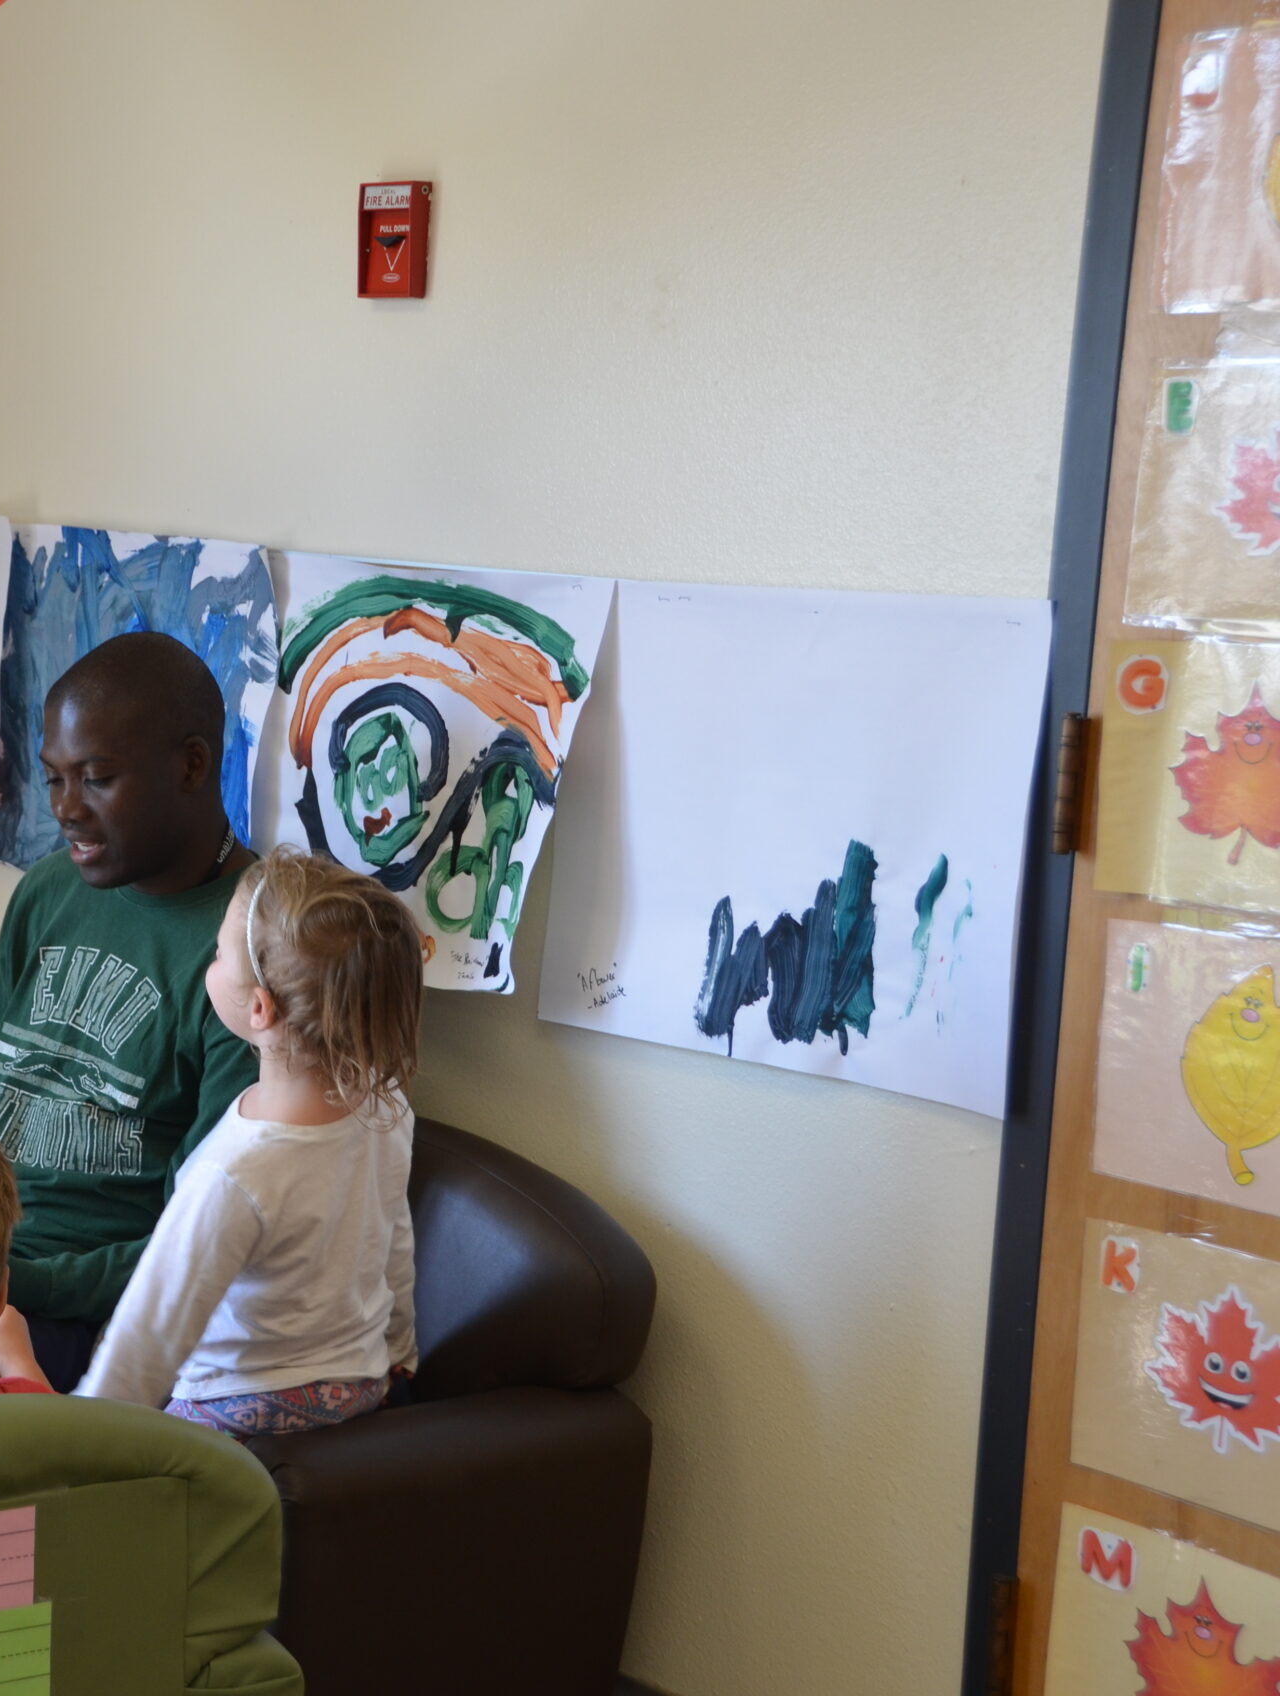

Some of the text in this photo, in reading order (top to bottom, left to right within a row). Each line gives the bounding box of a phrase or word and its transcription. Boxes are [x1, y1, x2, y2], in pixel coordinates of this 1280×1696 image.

[365, 195, 411, 206] FIRE ALARM
[379, 224, 410, 233] PULL DOWN
[1120, 658, 1165, 708] G
[30, 945, 162, 1056] ENMU
[1102, 1239, 1137, 1291] K
[1081, 1528, 1134, 1589] M
